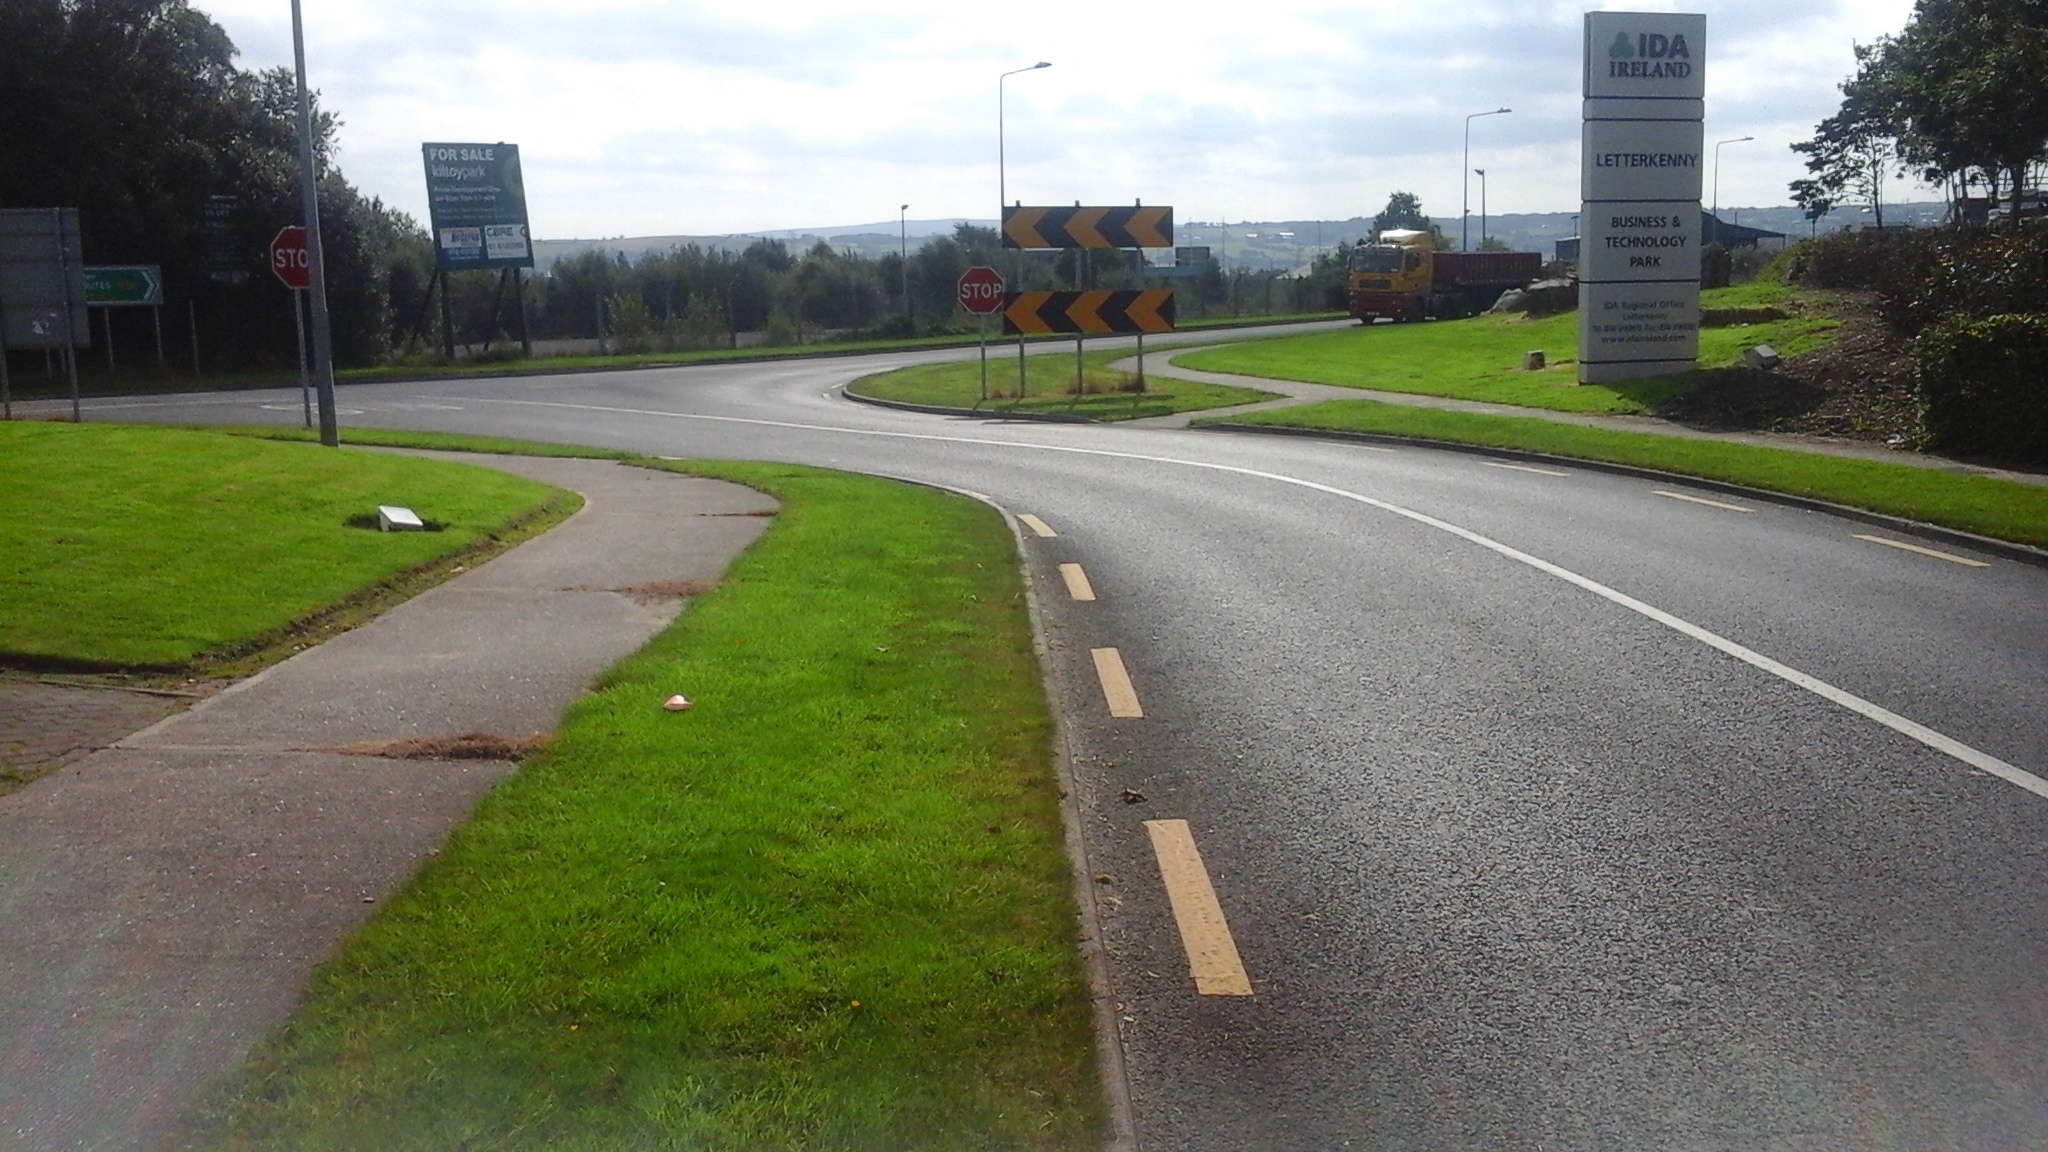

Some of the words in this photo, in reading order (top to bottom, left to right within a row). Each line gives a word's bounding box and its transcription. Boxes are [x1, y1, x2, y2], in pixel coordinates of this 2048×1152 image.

[1639, 32, 1690, 58] IDA
[1609, 61, 1691, 78] IRELAND
[430, 148, 458, 161] FOR
[461, 147, 495, 161] SALE
[1596, 153, 1698, 167] LETTERKENNY
[1611, 216, 1667, 228] BUSINESS
[1672, 215, 1682, 228] &
[1604, 236, 1687, 248] TECHNOLOGY
[275, 248, 308, 268] STO
[1629, 256, 1662, 268] PARK
[961, 283, 1002, 299] STOP
